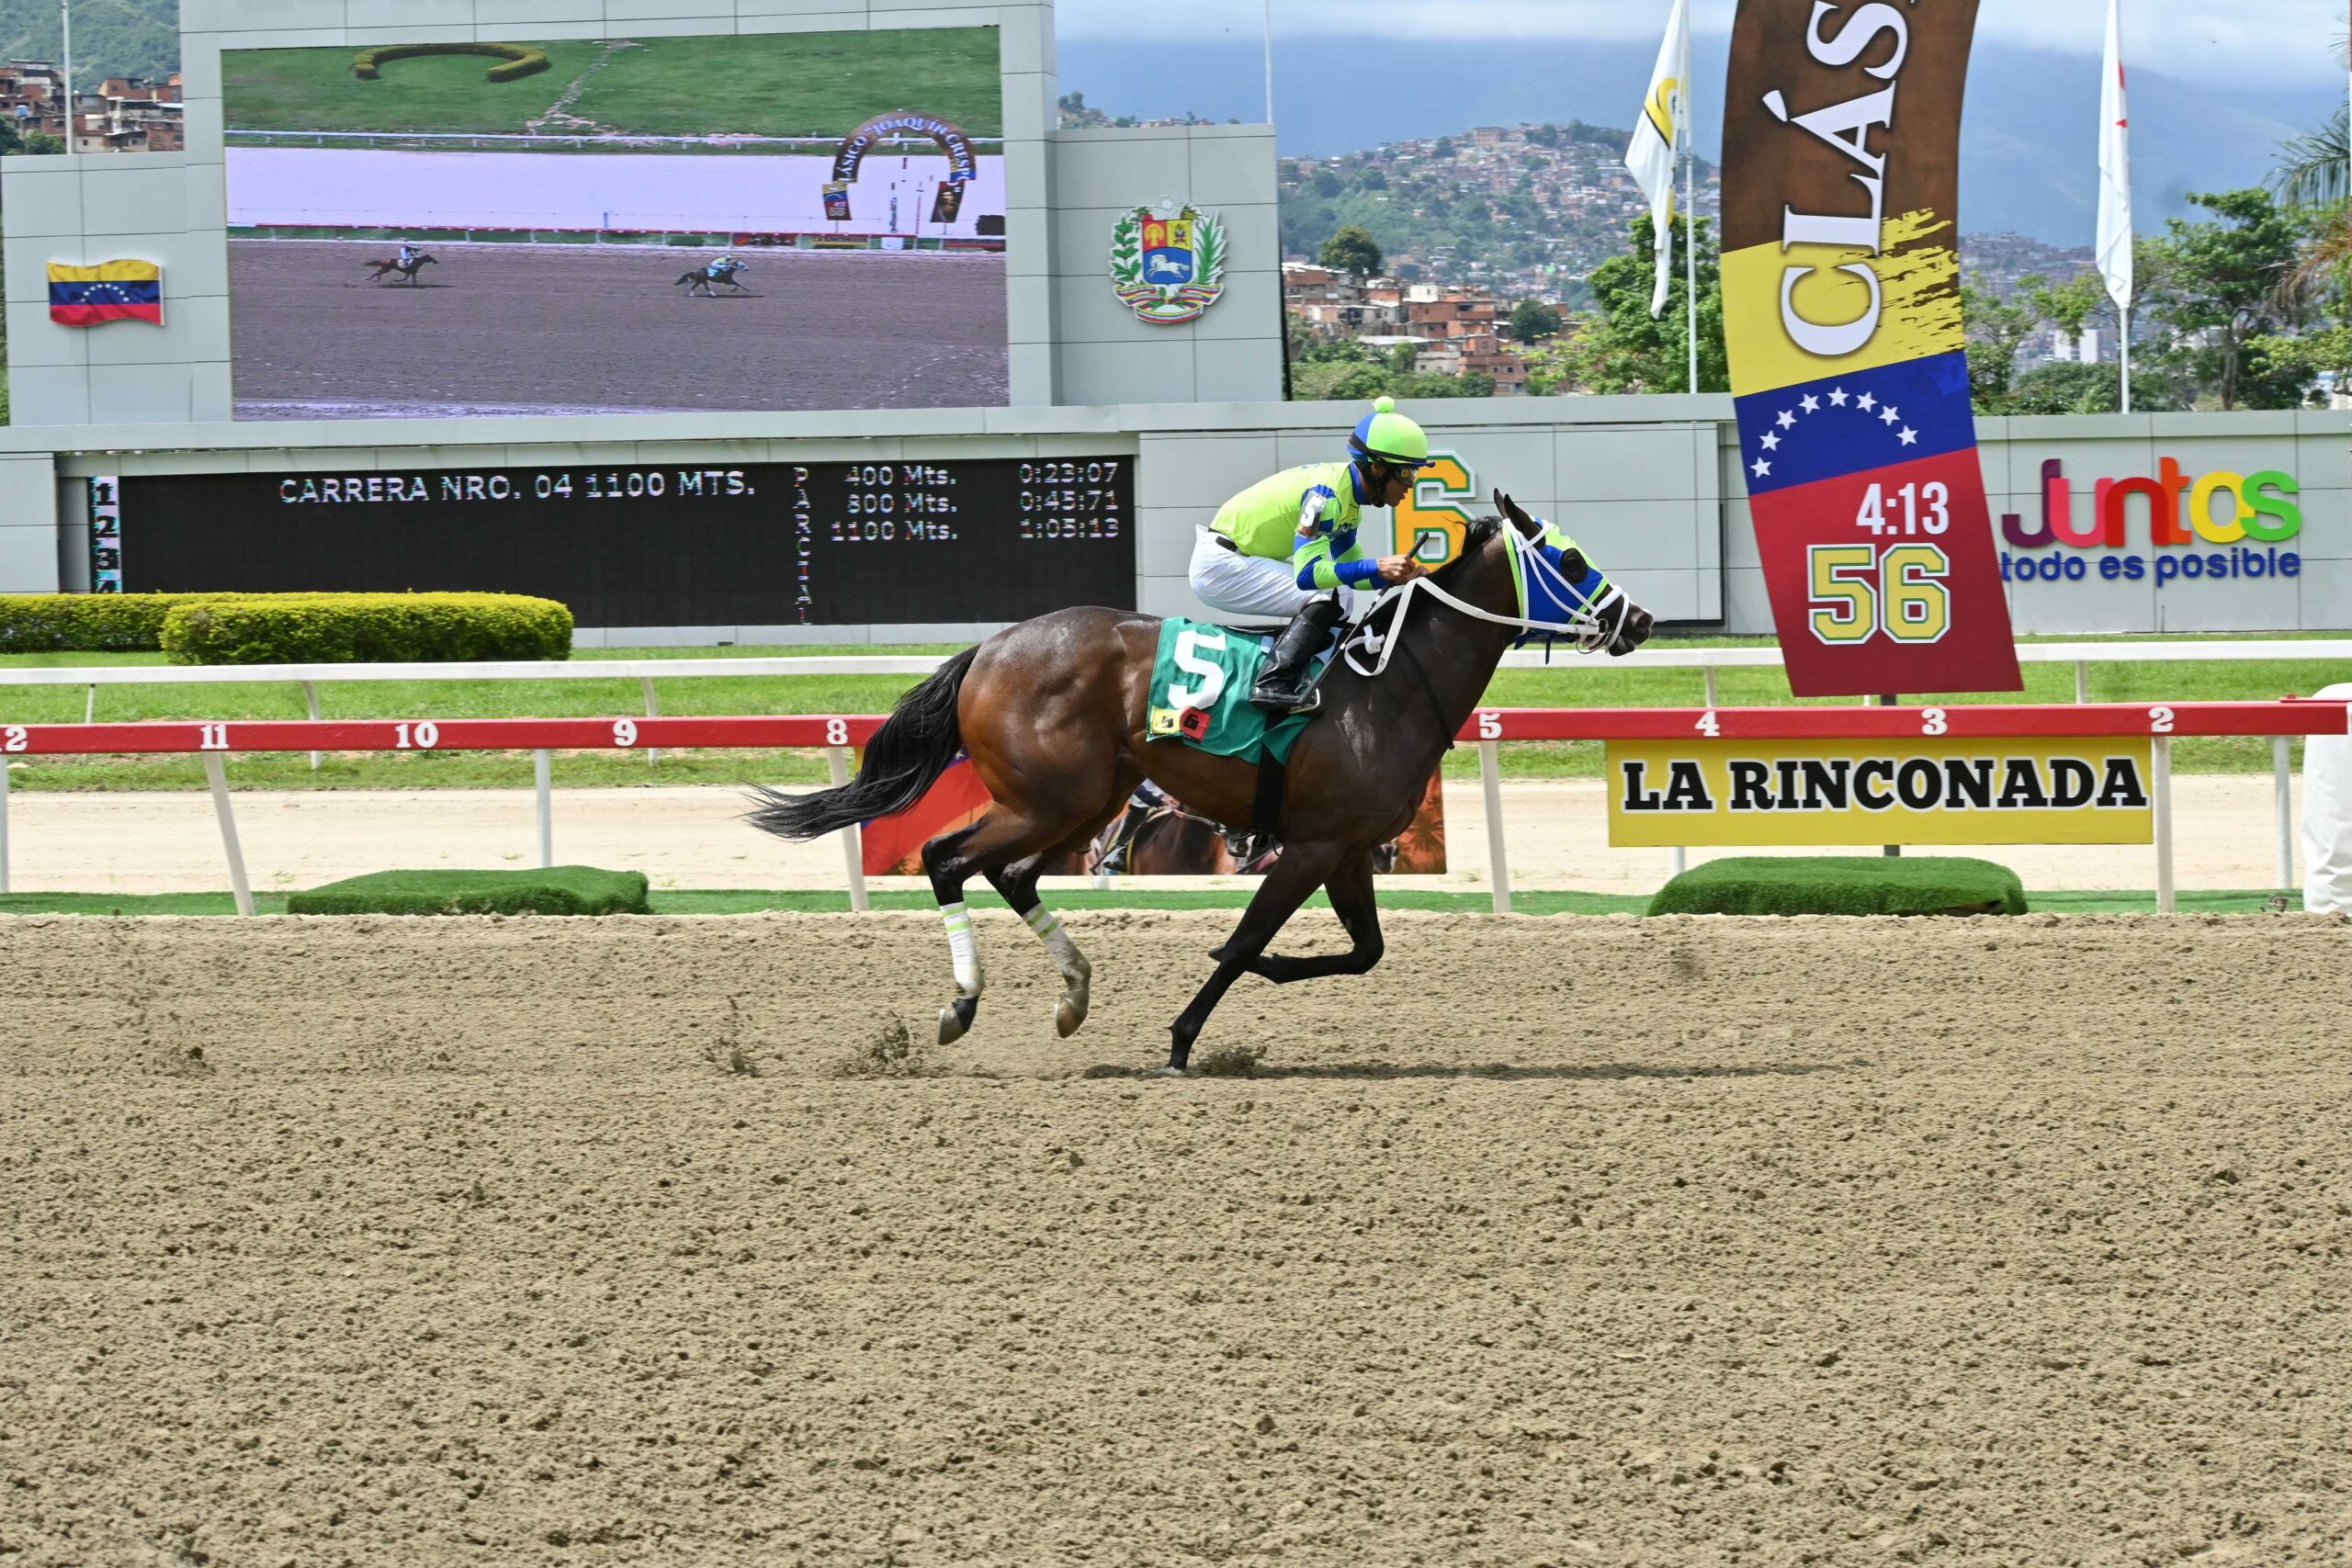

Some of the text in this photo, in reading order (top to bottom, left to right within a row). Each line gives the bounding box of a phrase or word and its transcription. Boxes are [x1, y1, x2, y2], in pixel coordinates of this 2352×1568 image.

[279, 469, 755, 503] CARRERA NRO. 04 1100 MTS.
[845, 462, 1119, 486] 400 Mts. 0:23:07
[96, 483, 117, 505] 1
[847, 490, 1119, 513] 800 Mts. 0:45:71
[2001, 457, 2302, 548] Juntos
[1300, 493, 1327, 527] 5
[1385, 449, 1478, 572] 6
[1856, 481, 1950, 535] 4:13
[94, 515, 118, 537] 2
[831, 517, 1119, 541] 1100 Mts. 1:05:13
[96, 548, 119, 570] 3
[2001, 547, 2301, 587] todo es posible
[1806, 542, 1951, 645] 56
[1167, 630, 1227, 710] 5
[613, 719, 638, 746] 9
[827, 719, 848, 745] 8
[1478, 714, 1503, 739] 5
[1695, 711, 1720, 737] 4
[1921, 708, 1948, 736] 3
[2148, 706, 2174, 733] 2
[0, 726, 28, 751] 2
[200, 724, 229, 750] 11
[395, 722, 439, 749] 10
[1622, 758, 2148, 812] LA RINCONADA
